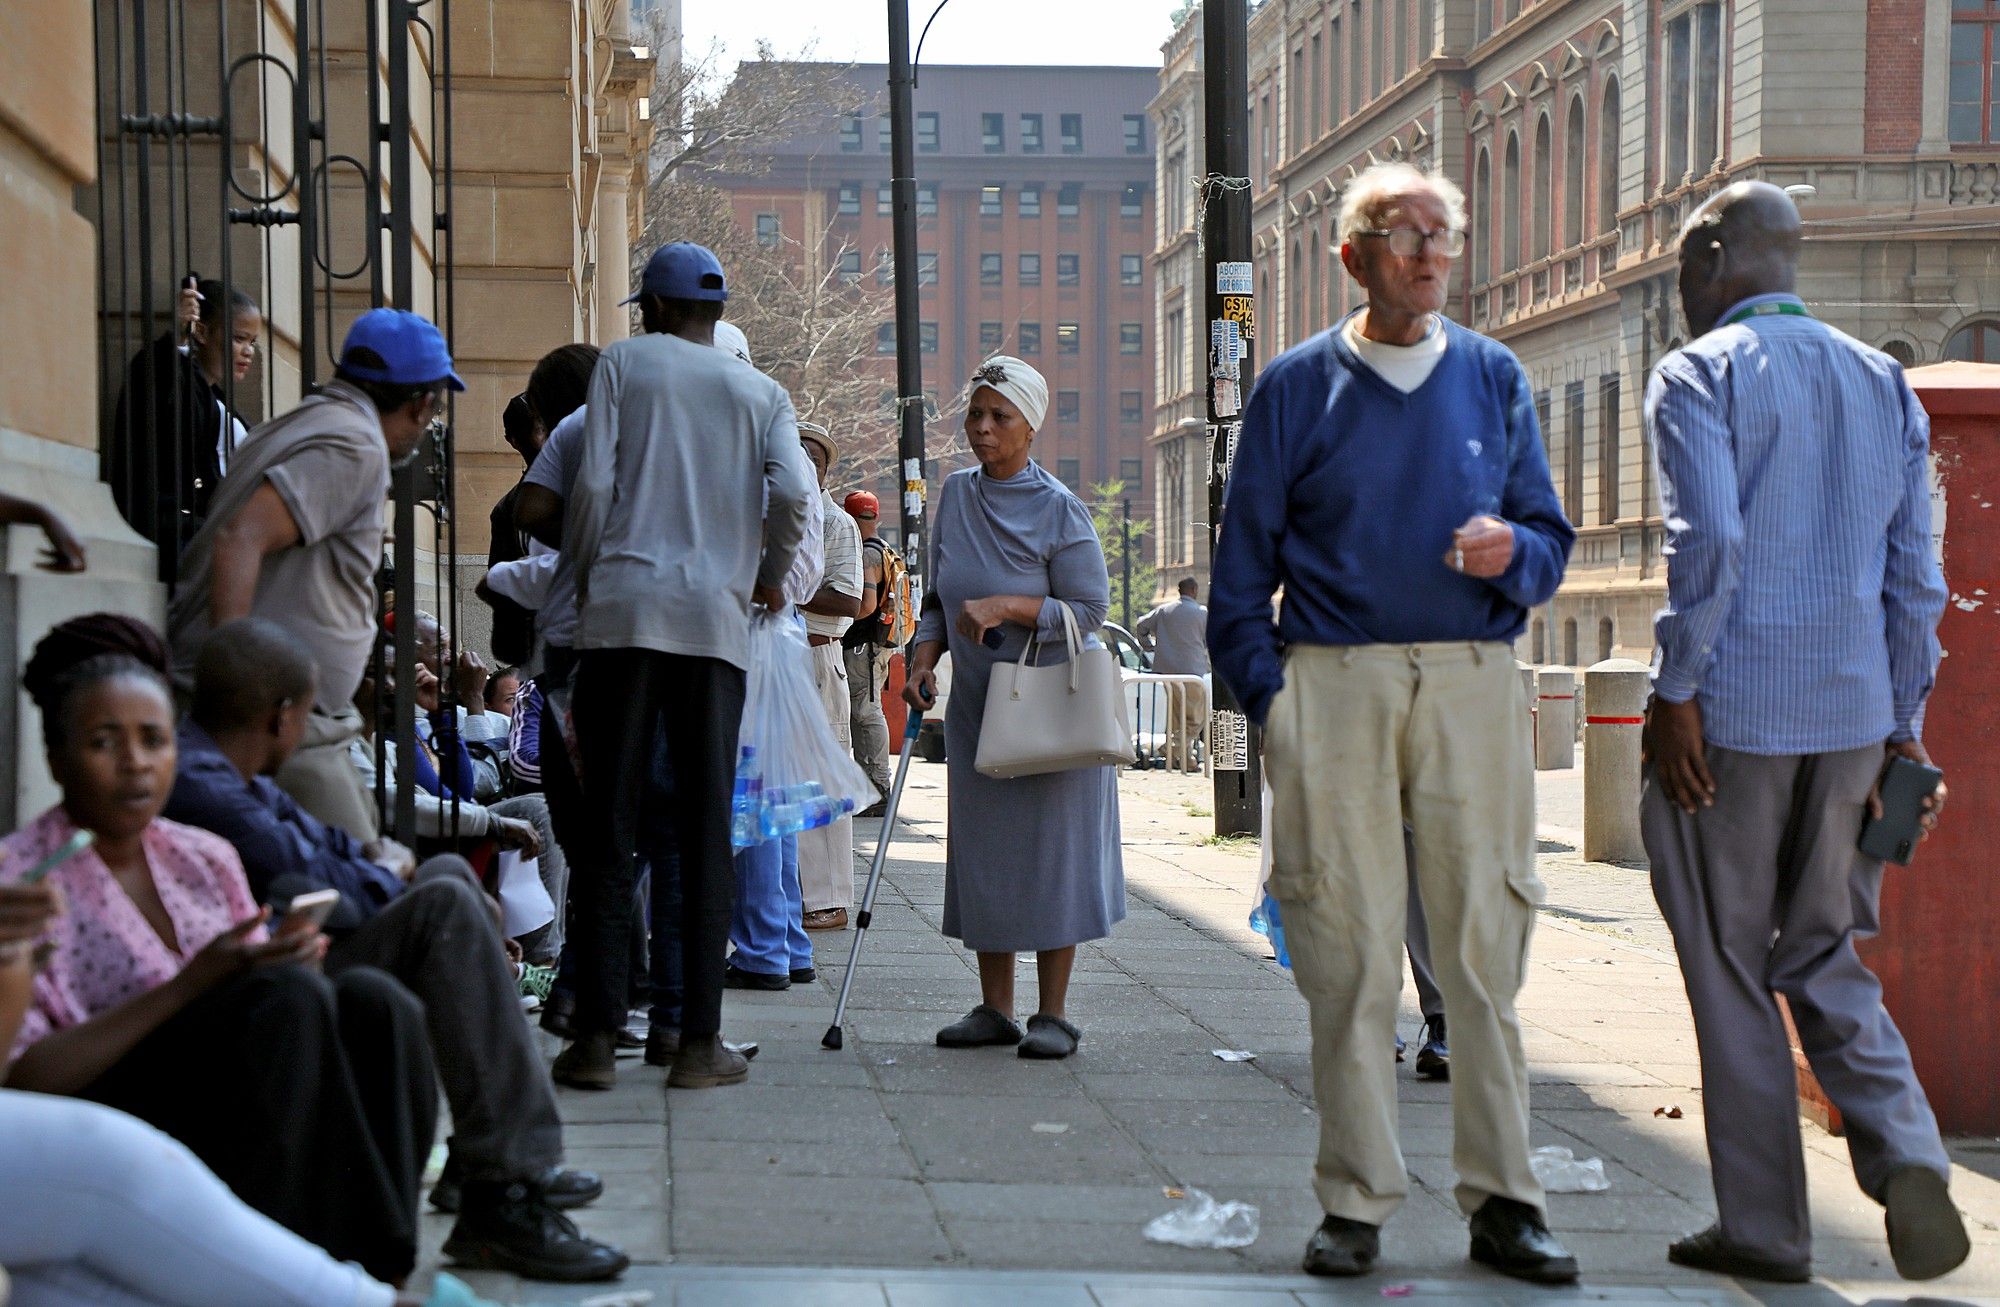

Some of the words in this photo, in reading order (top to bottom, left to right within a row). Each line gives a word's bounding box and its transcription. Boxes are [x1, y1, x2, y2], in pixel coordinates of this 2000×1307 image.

[1219, 264, 1251, 276] ABORTION
[1229, 321, 1239, 363] ABORTION
[1233, 736, 1246, 750] 712
[1233, 752, 1246, 768] 072
